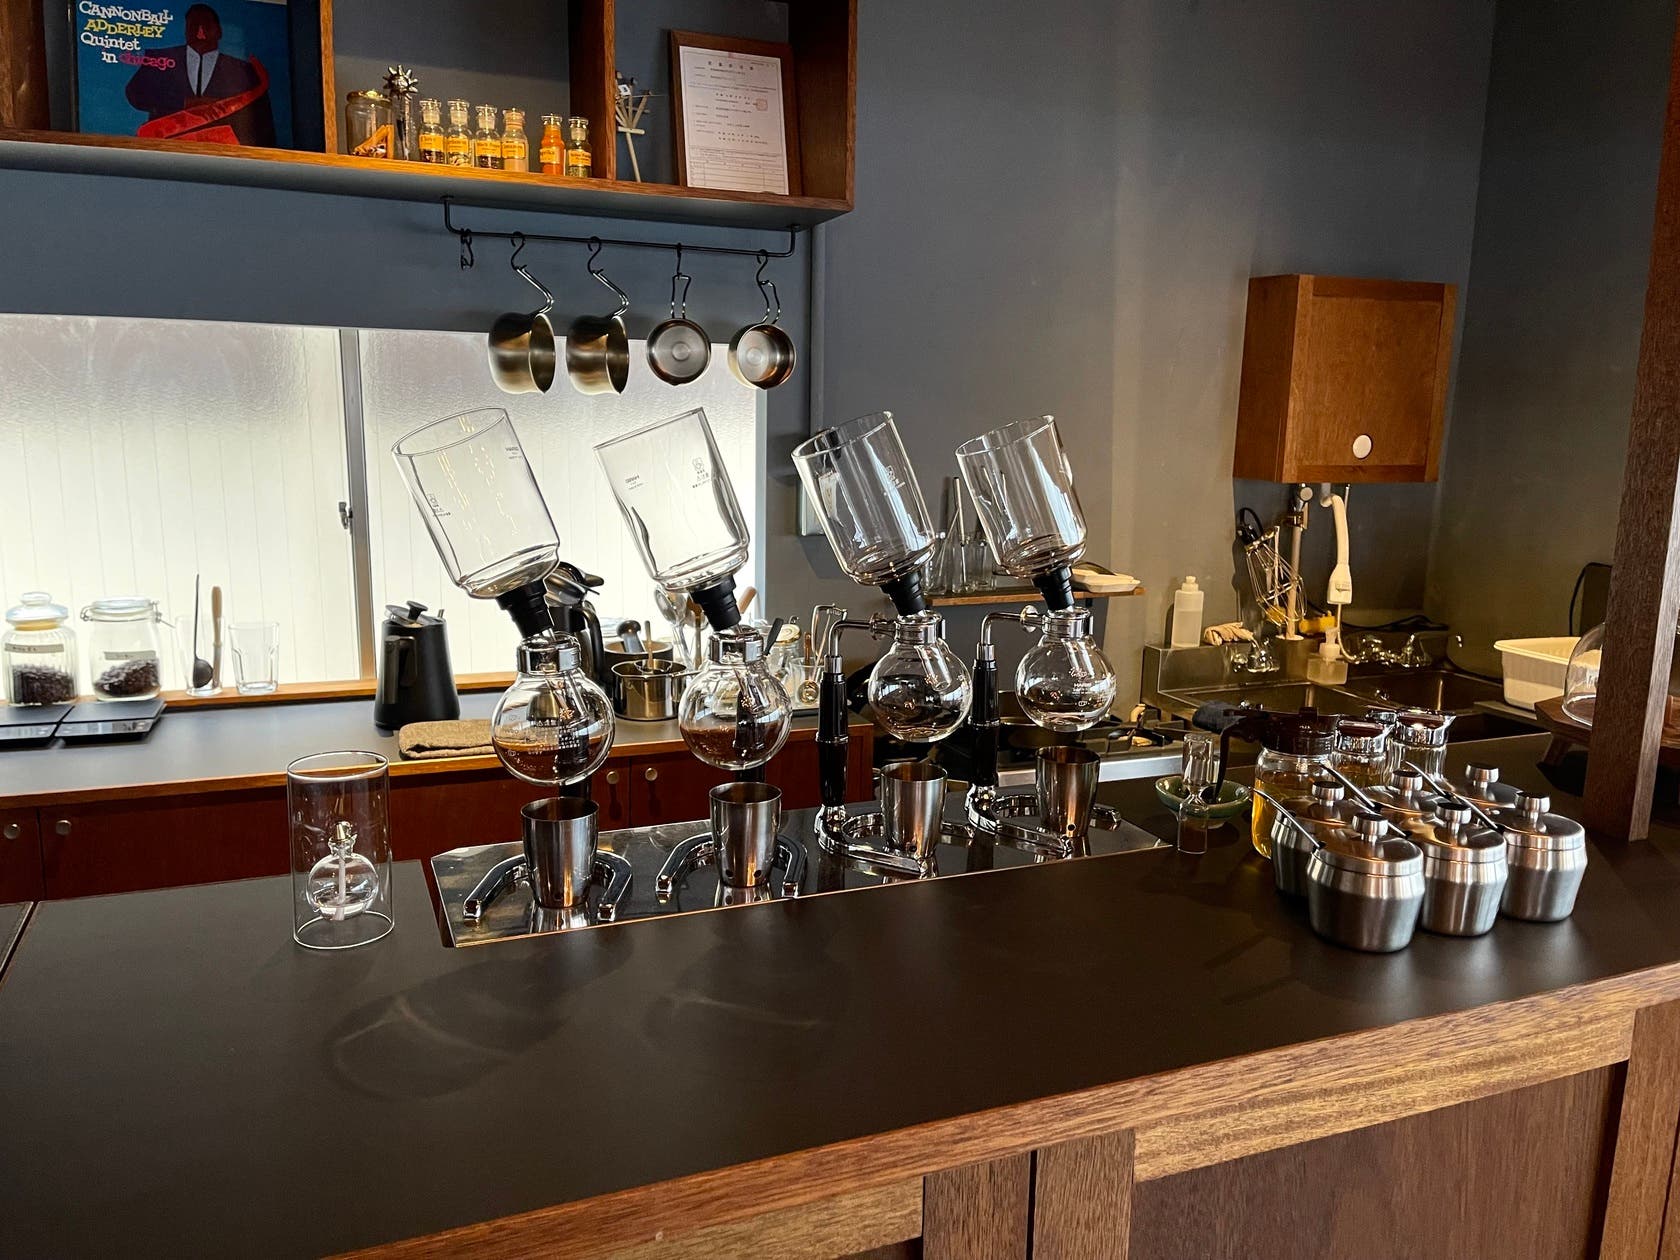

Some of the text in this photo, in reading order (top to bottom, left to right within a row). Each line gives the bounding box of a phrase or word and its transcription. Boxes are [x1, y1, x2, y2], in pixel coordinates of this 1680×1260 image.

[79, 1, 173, 24] CANNONBALL
[84, 19, 165, 37] ADDERLEY
[80, 32, 141, 50] Quintet
[101, 51, 176, 70] in chicago
